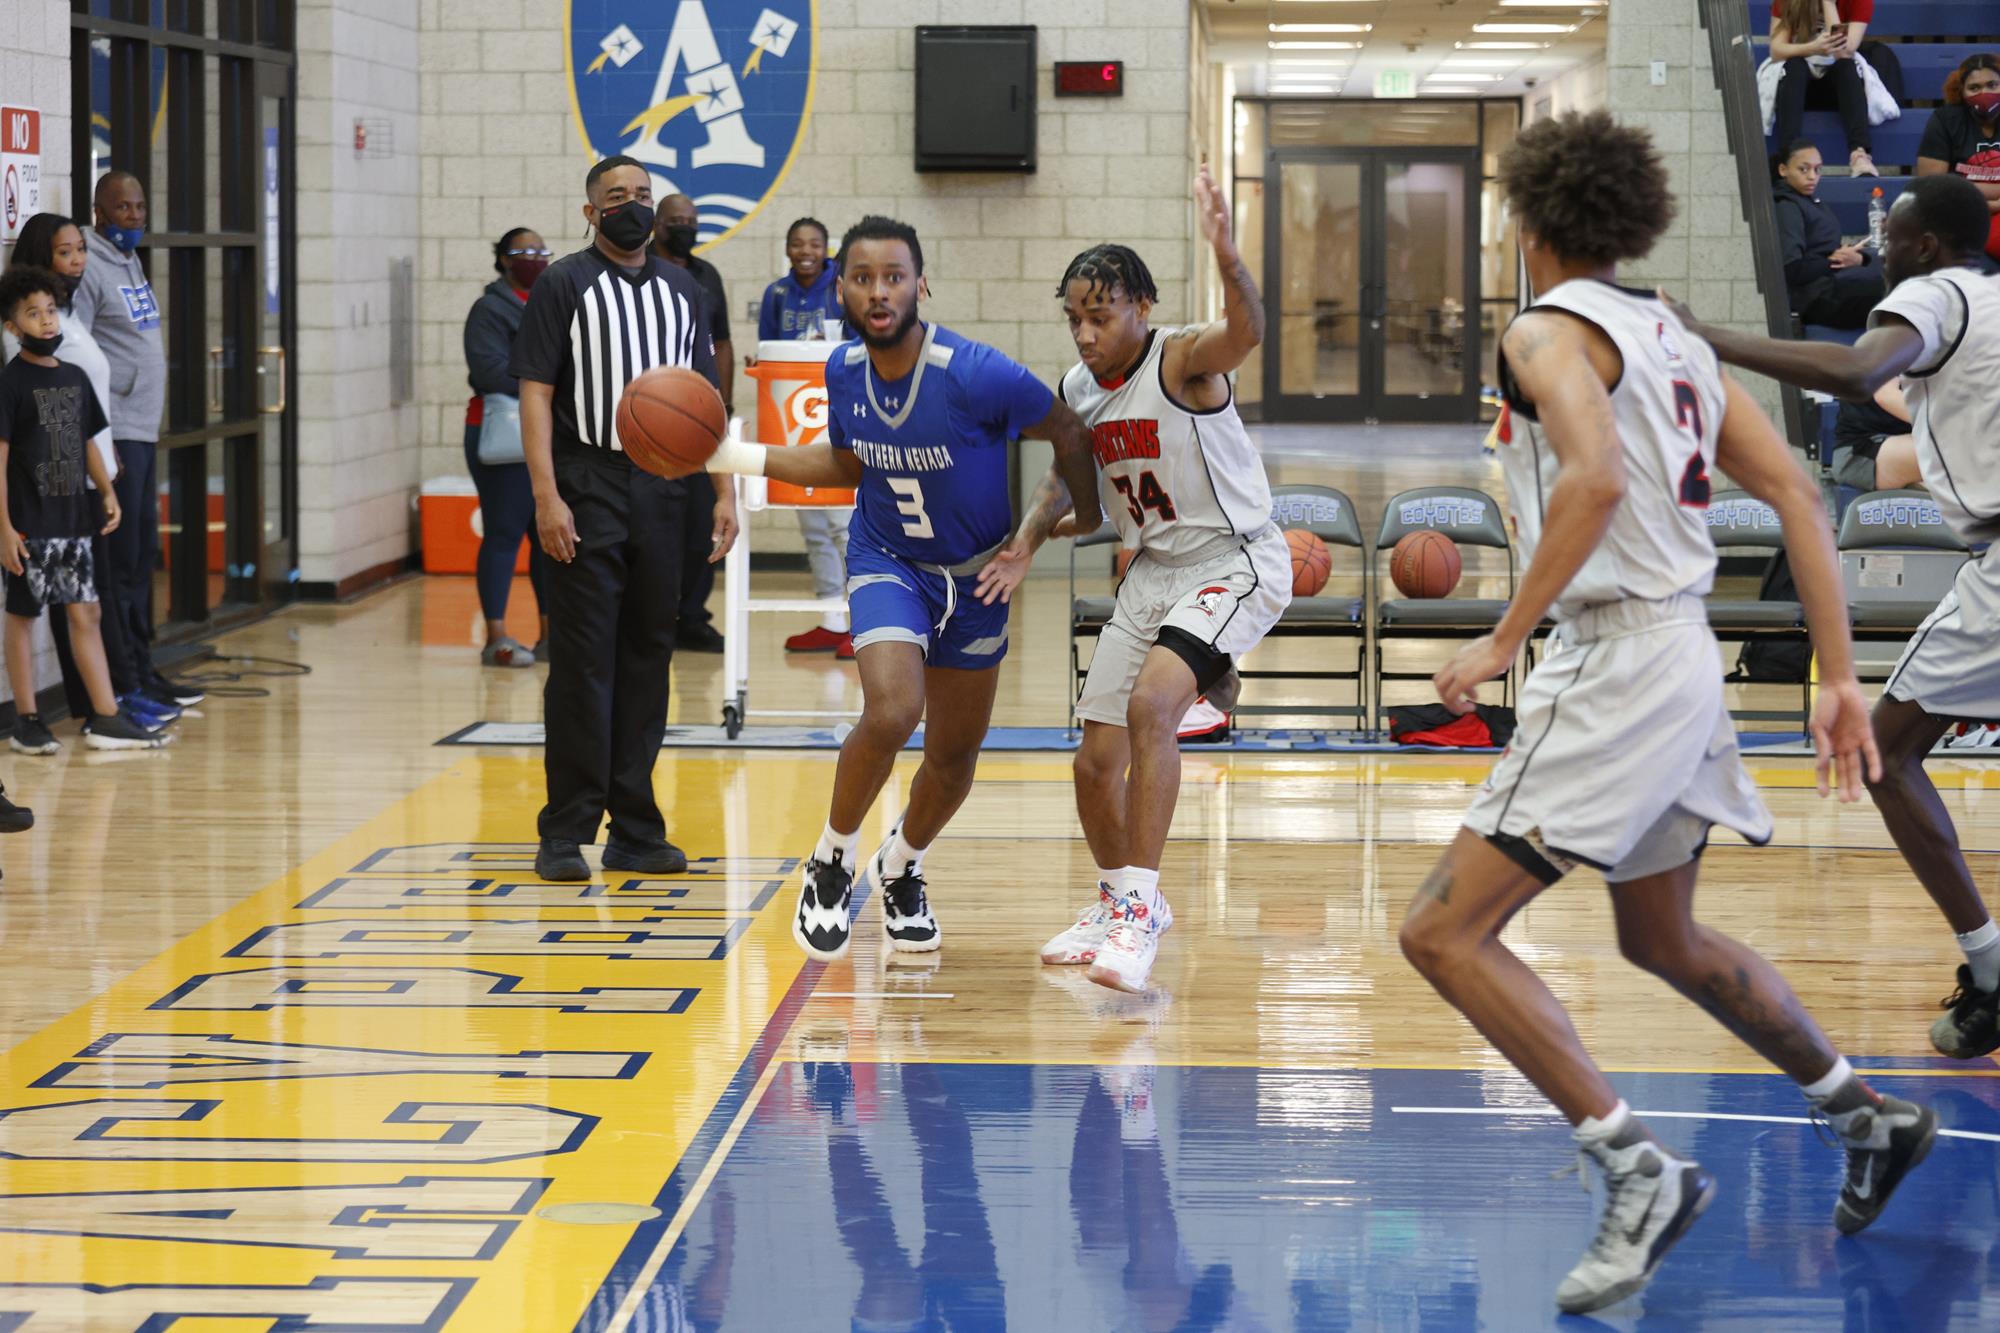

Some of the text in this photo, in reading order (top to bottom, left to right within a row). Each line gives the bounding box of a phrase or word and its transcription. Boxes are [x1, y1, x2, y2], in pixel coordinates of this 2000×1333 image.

[12, 113, 29, 150] NO
[791, 387, 829, 429] G
[851, 438, 954, 472] SOUTHERN NEVADA
[1089, 418, 1161, 470] PARTANS
[1672, 380, 1712, 509] 2
[886, 477, 935, 539] 3
[1110, 470, 1178, 528] 34
[1270, 500, 1339, 526] OYOTES
[1400, 504, 1484, 528] COYOTES
[1859, 505, 1943, 529] COYOTES
